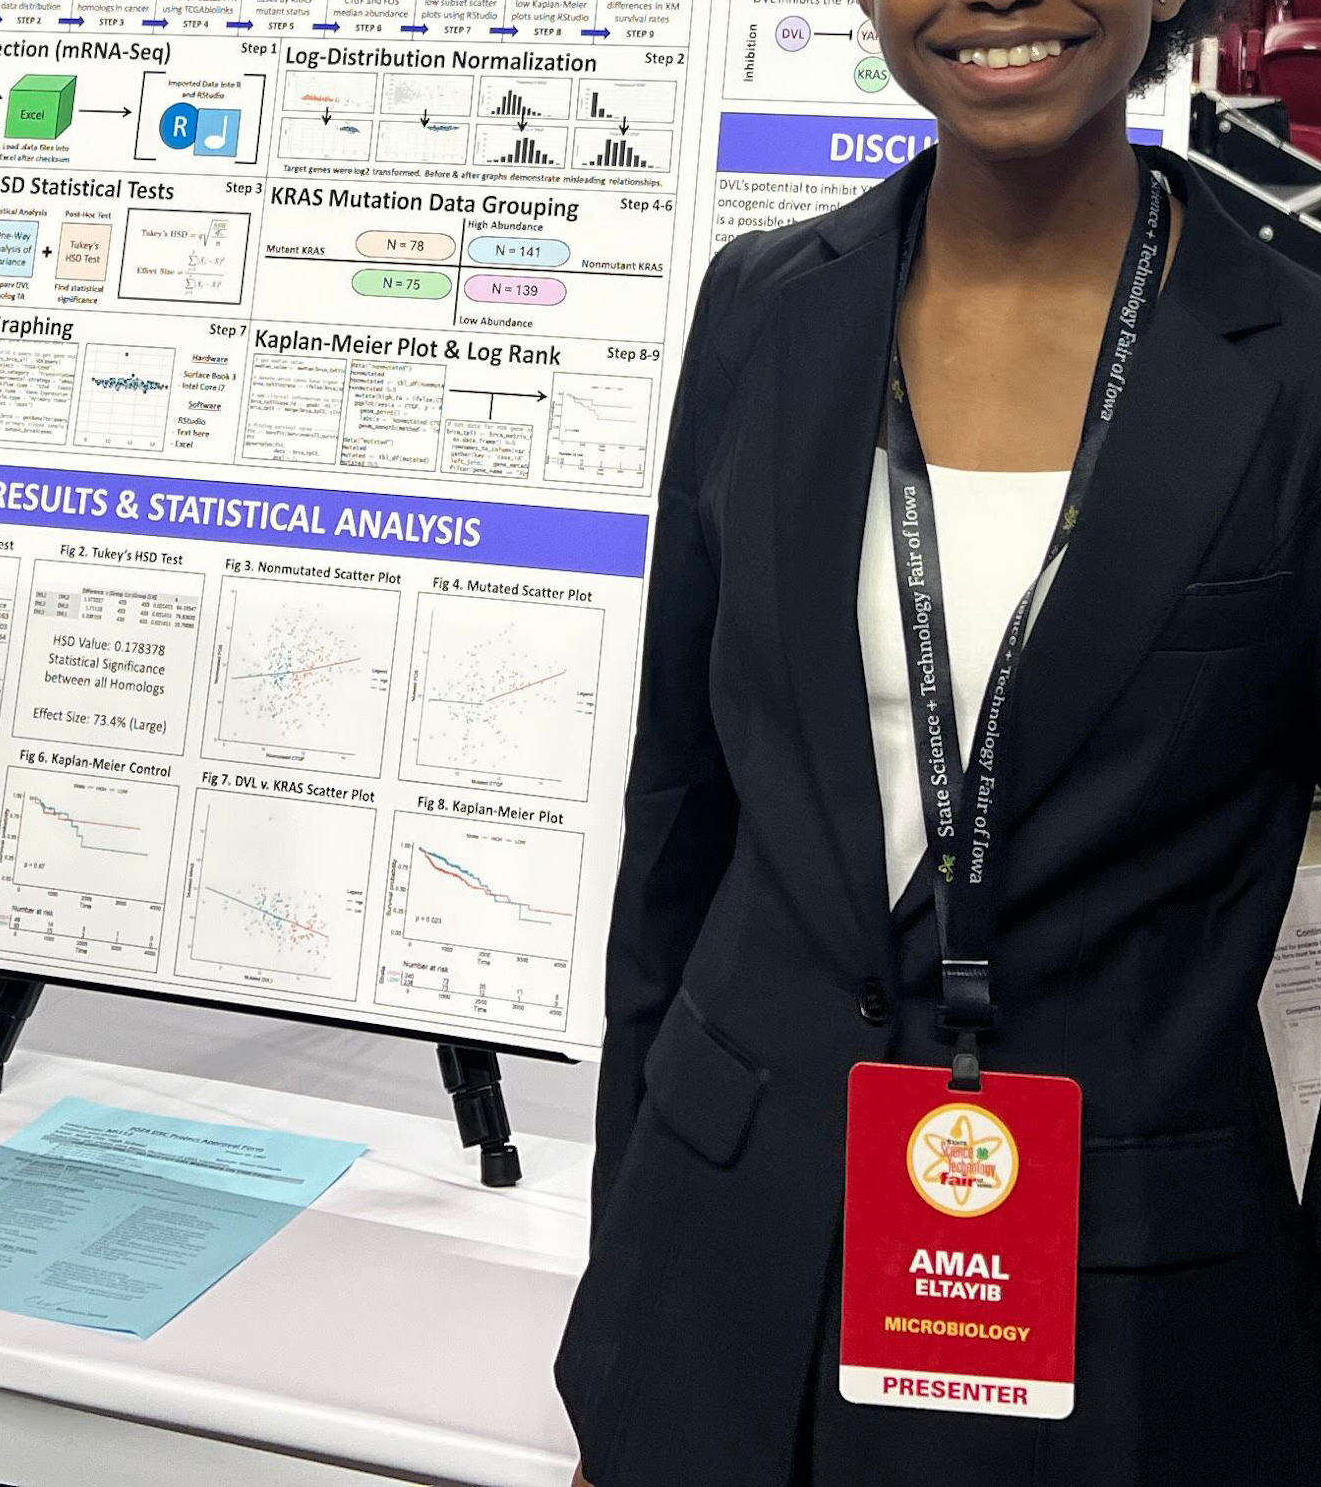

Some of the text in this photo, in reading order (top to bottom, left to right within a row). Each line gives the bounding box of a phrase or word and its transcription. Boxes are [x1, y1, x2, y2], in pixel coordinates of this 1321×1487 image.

[55, 39, 171, 65] (mRNA-Seq)
[286, 46, 598, 73] Log-Distribution Normalization
[829, 132, 935, 164] DISCU
[30, 177, 122, 198] Statistical
[127, 181, 174, 200] Tests
[271, 186, 580, 222] KRAS Mutation Data Grouping
[255, 329, 561, 368] Kaplan-Meier Plot & Log Rank
[116, 490, 139, 519] &
[148, 493, 325, 534] STATISTICAL
[334, 508, 480, 547] ANALYSIS
[902, 484, 954, 838] State Science Technology Fair of Iowa
[910, 1250, 1009, 1280] AMAL
[916, 1280, 1001, 1302] ELTAYIB
[885, 1316, 1030, 1341] MICROBIOLOGY
[883, 1376, 1028, 1406] PRESENTER
